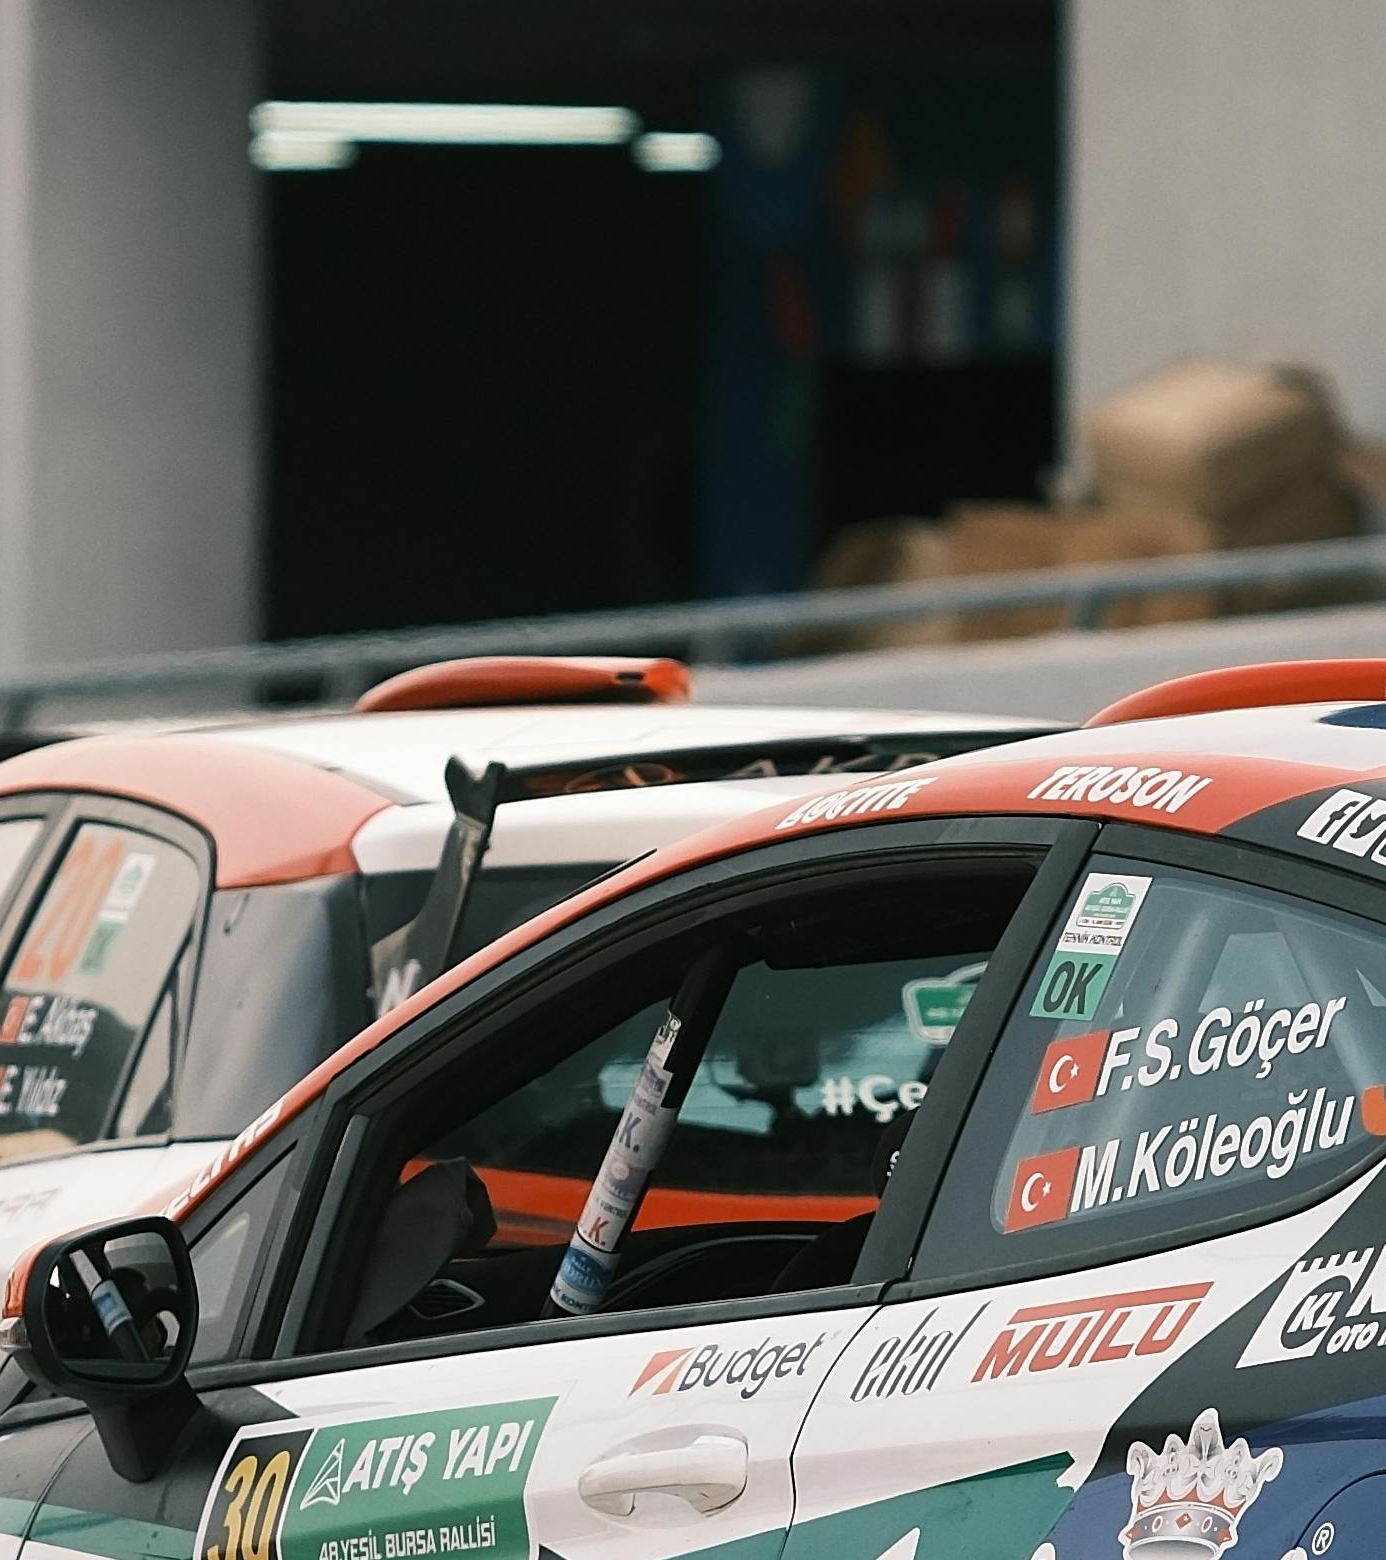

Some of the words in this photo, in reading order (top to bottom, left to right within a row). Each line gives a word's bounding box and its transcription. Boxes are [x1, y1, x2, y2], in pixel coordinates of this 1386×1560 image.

[774, 776, 940, 830] LOCTITE
[1026, 766, 1214, 814] TEROSON
[1043, 960, 1104, 1015] OK
[1097, 996, 1347, 1097] F.S.Göçer
[1070, 1087, 1356, 1214] M.Köleoğlu
[970, 1281, 1215, 1383] MUTLU
[1325, 1321, 1380, 1355] OTO
[677, 1332, 826, 1400] Budget
[342, 1431, 435, 1495] ATIŞ
[443, 1420, 535, 1481] YAPI
[385, 1529, 437, 1557] BURSA
